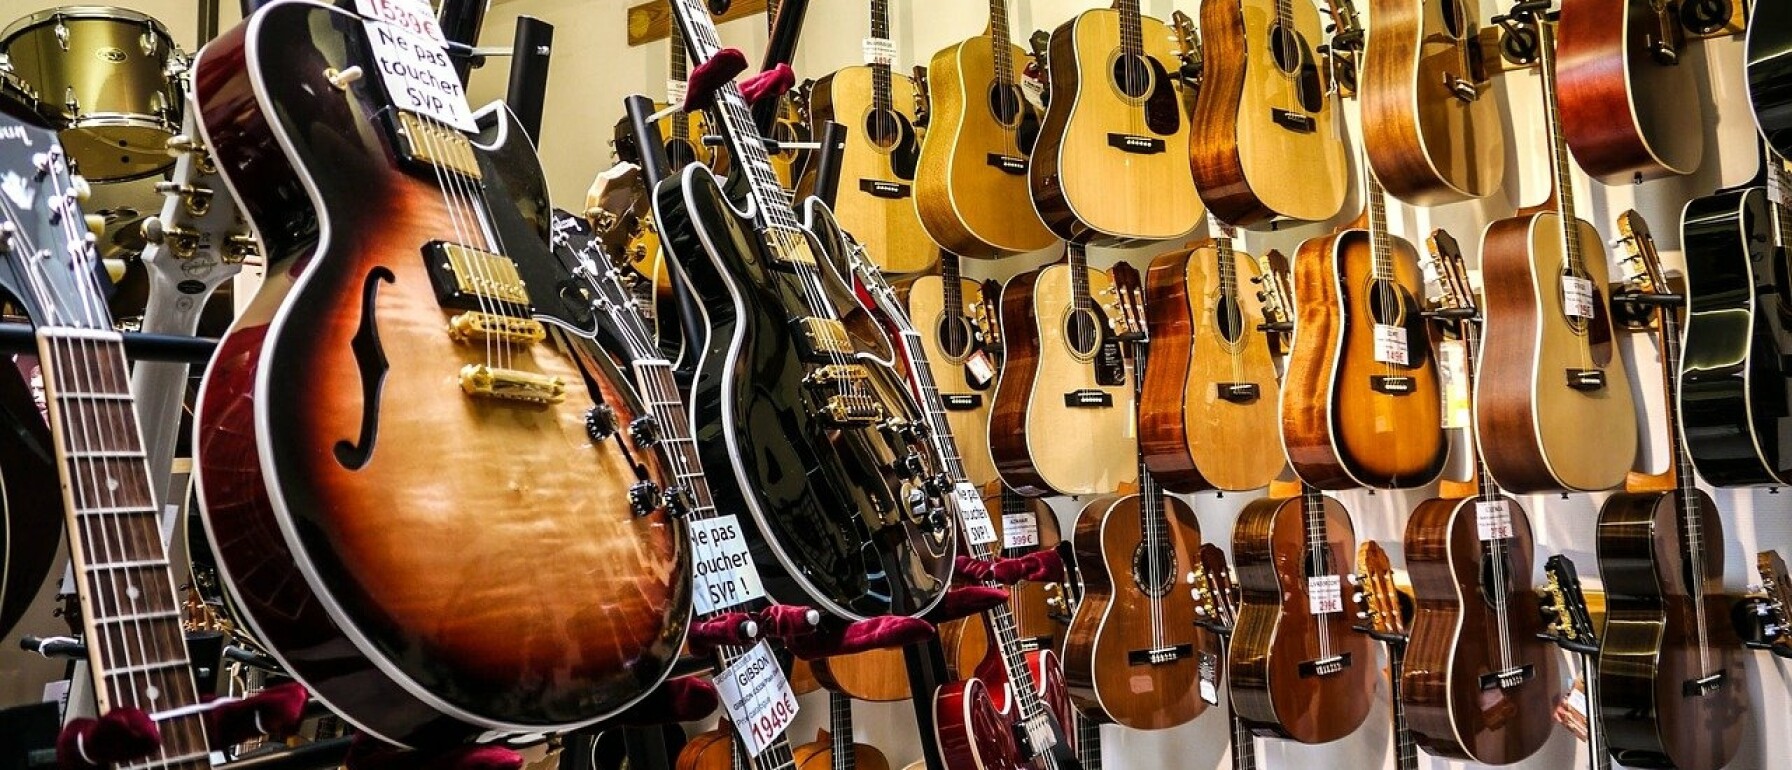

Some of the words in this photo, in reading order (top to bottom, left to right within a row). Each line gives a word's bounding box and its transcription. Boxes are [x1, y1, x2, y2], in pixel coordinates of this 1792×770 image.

[378, 27, 408, 51] Ne
[414, 44, 447, 67] pas
[380, 56, 459, 96] toucher
[406, 87, 443, 114] SVP
[449, 103, 459, 122] !
[711, 525, 736, 547] pas
[1012, 534, 1033, 546] 399€
[693, 551, 748, 579] oucher
[708, 580, 736, 604] SVP
[740, 576, 750, 596] !
[738, 655, 770, 687] GIBSON
[752, 691, 795, 746] 1949€
